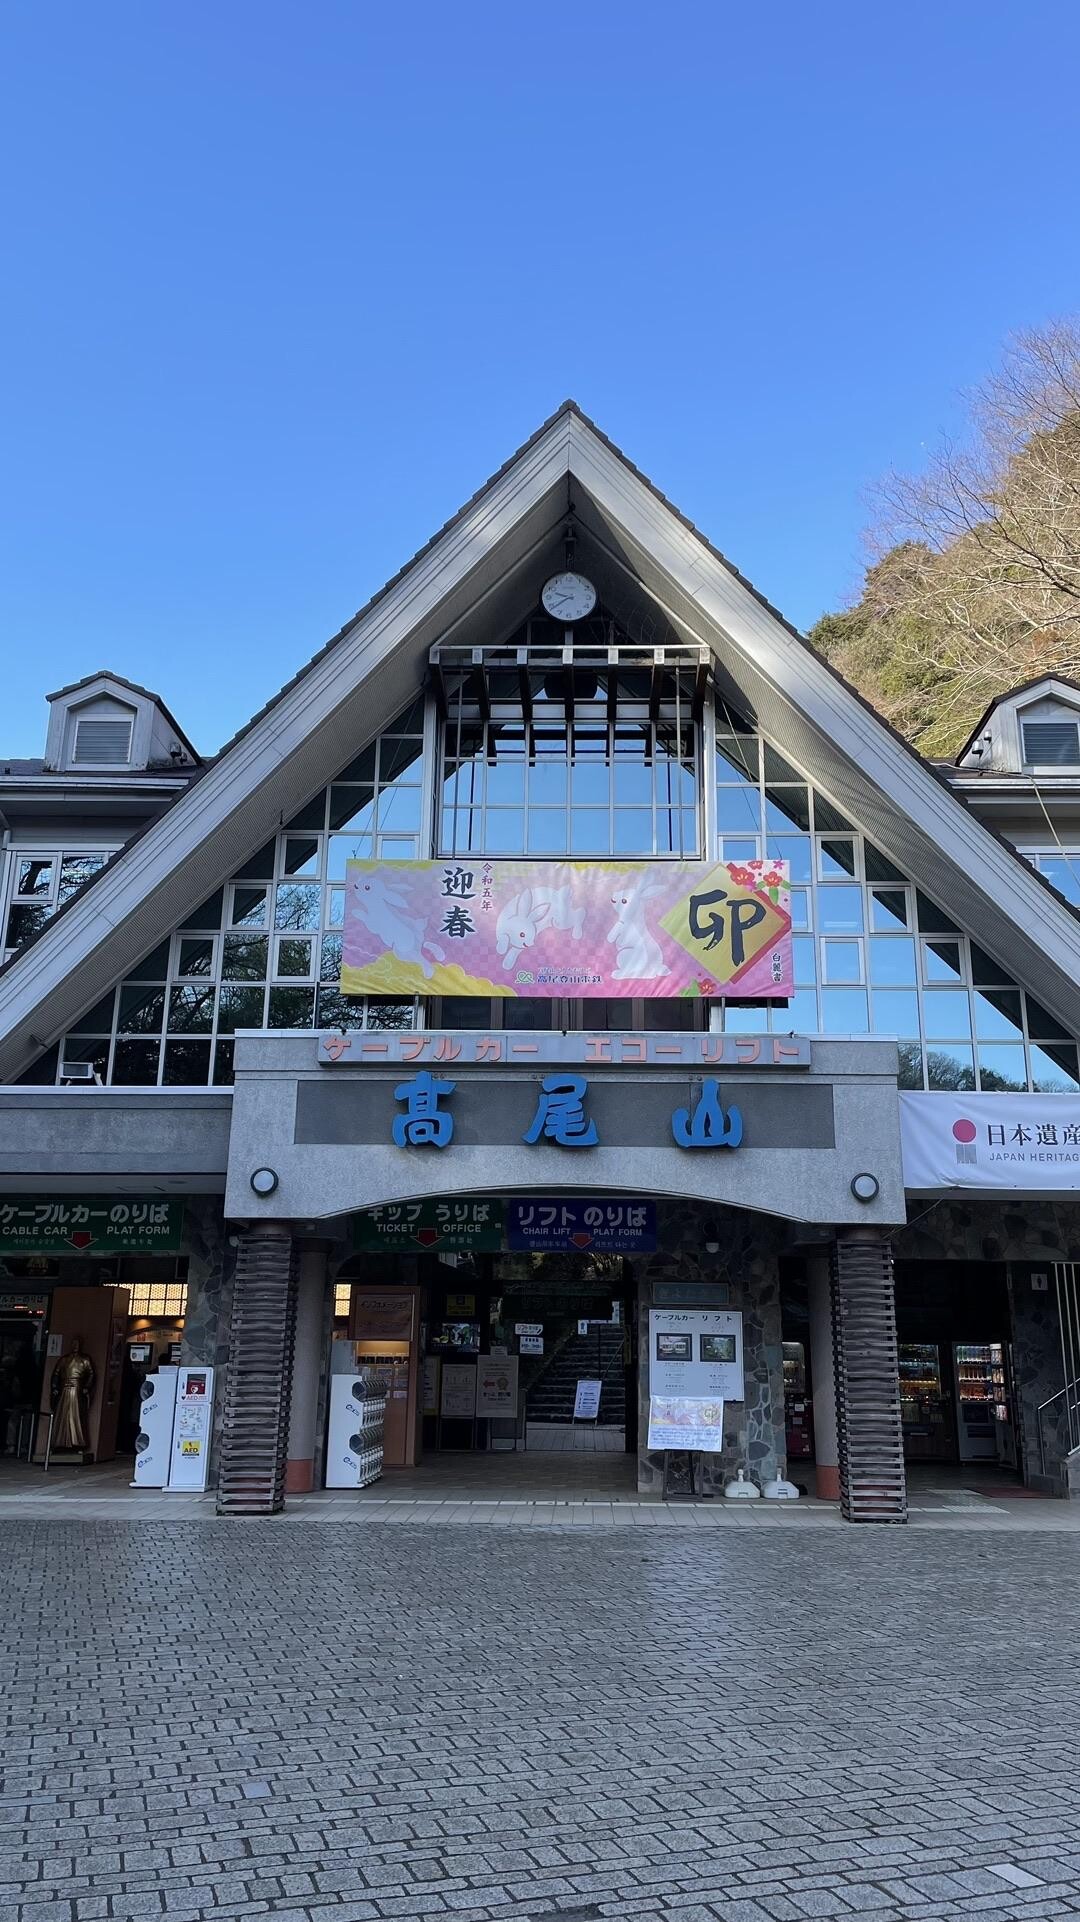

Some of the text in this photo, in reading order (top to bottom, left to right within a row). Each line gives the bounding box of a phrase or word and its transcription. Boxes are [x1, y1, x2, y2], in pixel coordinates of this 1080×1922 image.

[482, 862, 493, 911] 令和五年
[440, 867, 476, 938] 迎春
[323, 1035, 799, 1063] ケーブルカー エコーリフト
[987, 1123, 1080, 1146] 日本遺産
[990, 1153, 1025, 1161] JAPAN
[0, 1204, 169, 1223] ケーブルカーのりば
[436, 1204, 490, 1221] うりば
[518, 1206, 647, 1226] リフト のりば
[2, 1226, 170, 1235] CABLE CAR PLAT FORM
[376, 1224, 481, 1233] TICKET OFFICE
[522, 1227, 643, 1236] CHAIR LIFT PLAT FORM
